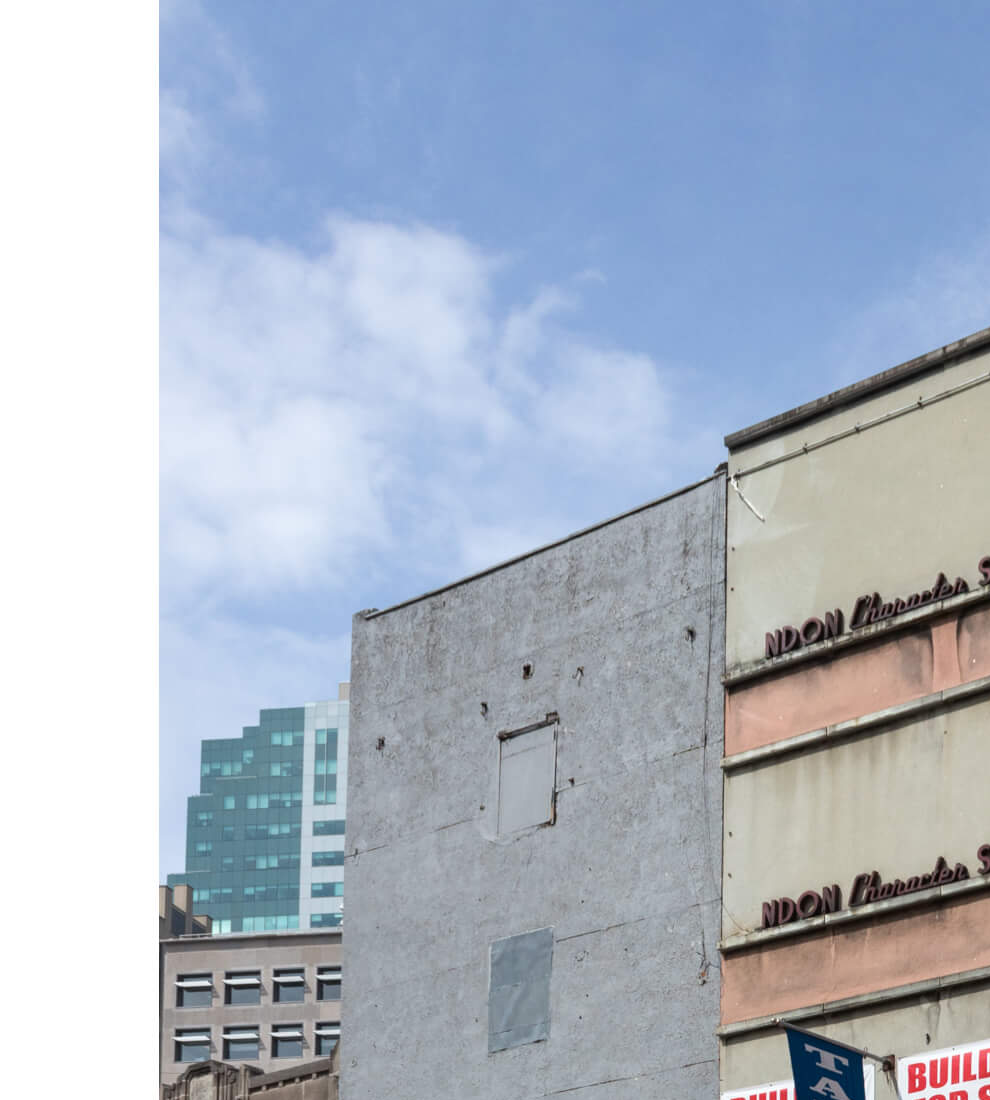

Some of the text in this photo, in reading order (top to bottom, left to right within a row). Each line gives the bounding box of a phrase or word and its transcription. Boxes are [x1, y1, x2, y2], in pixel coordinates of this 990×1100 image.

[765, 607, 843, 658] NDON
[850, 572, 969, 630] Character
[761, 884, 842, 929] NDON
[849, 856, 970, 907] Character
